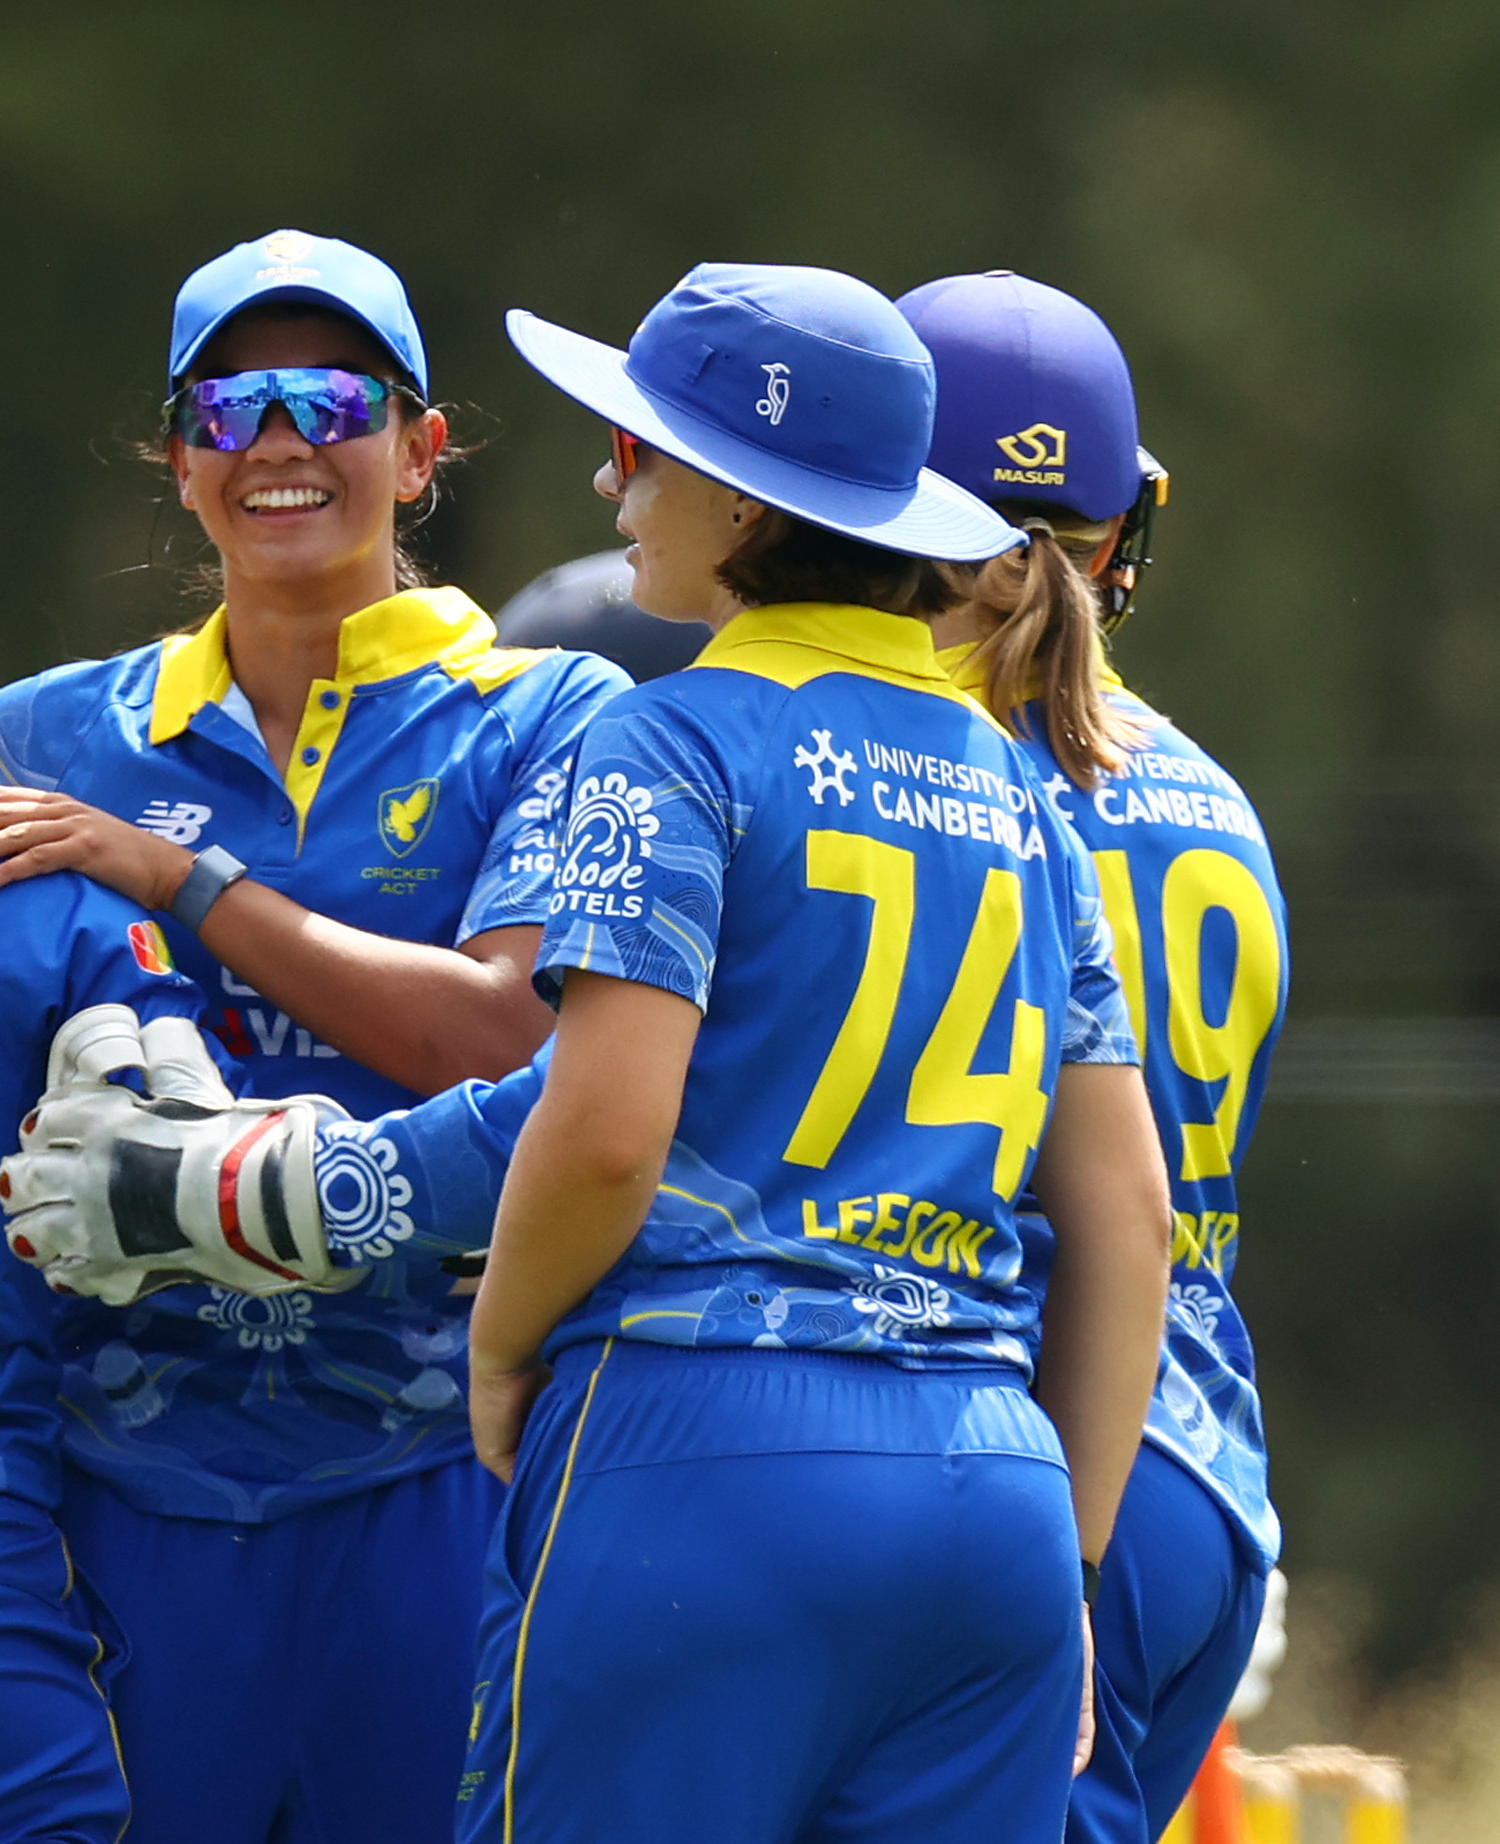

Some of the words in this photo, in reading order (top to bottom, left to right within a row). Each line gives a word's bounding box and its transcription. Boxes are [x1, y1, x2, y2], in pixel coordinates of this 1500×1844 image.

[993, 468, 1065, 486] MASURI
[863, 738, 1004, 802] UNIVERSITY
[872, 780, 1048, 861] CANBERRA
[360, 866, 441, 881] CRICKET
[378, 882, 418, 895] ACT
[554, 834, 649, 890] bode
[550, 889, 643, 919] OTELS
[782, 829, 1049, 1202] 74
[801, 1193, 996, 1279] LEESON
